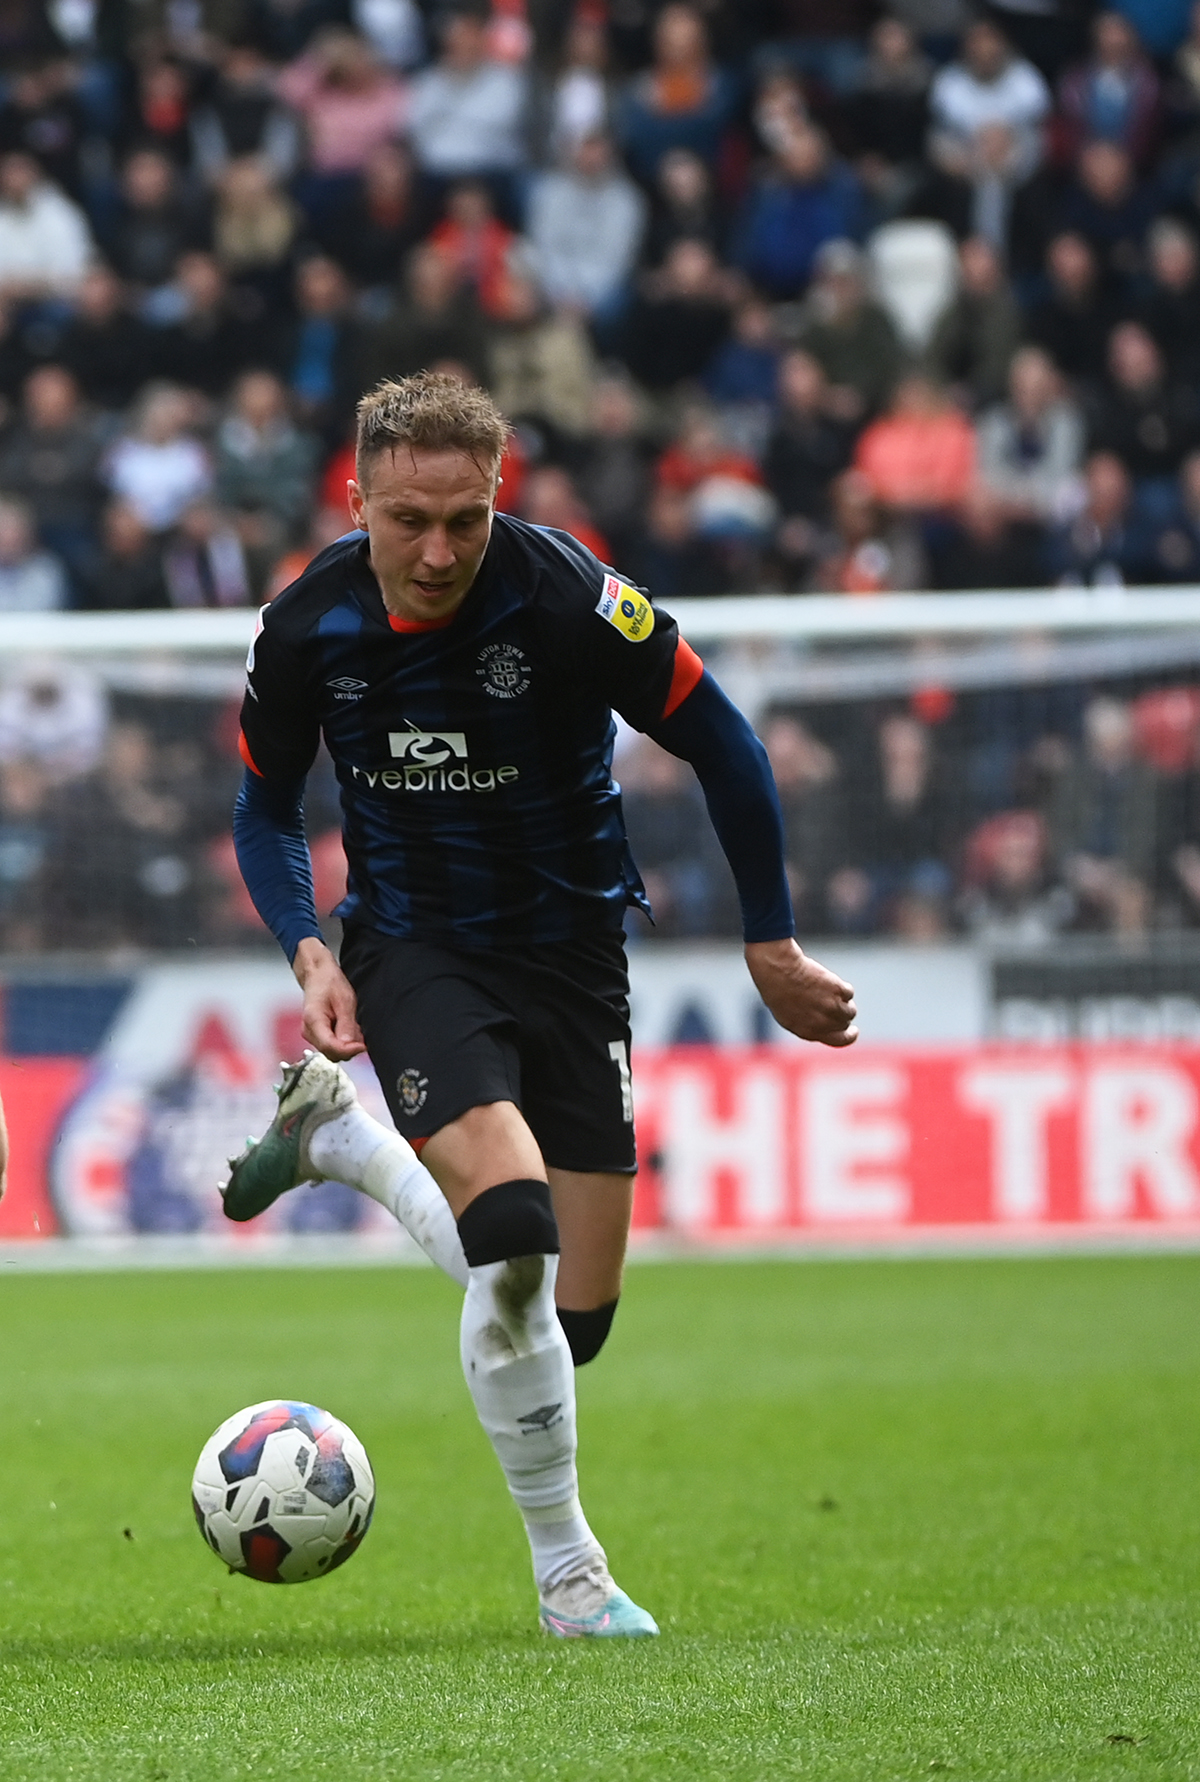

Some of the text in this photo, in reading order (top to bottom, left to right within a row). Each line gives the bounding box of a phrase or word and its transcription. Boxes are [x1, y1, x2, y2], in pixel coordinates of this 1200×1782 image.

[602, 597, 615, 616] sky
[477, 643, 525, 661] LUTON TOWN
[482, 678, 531, 698] FOOTBALL CLUB
